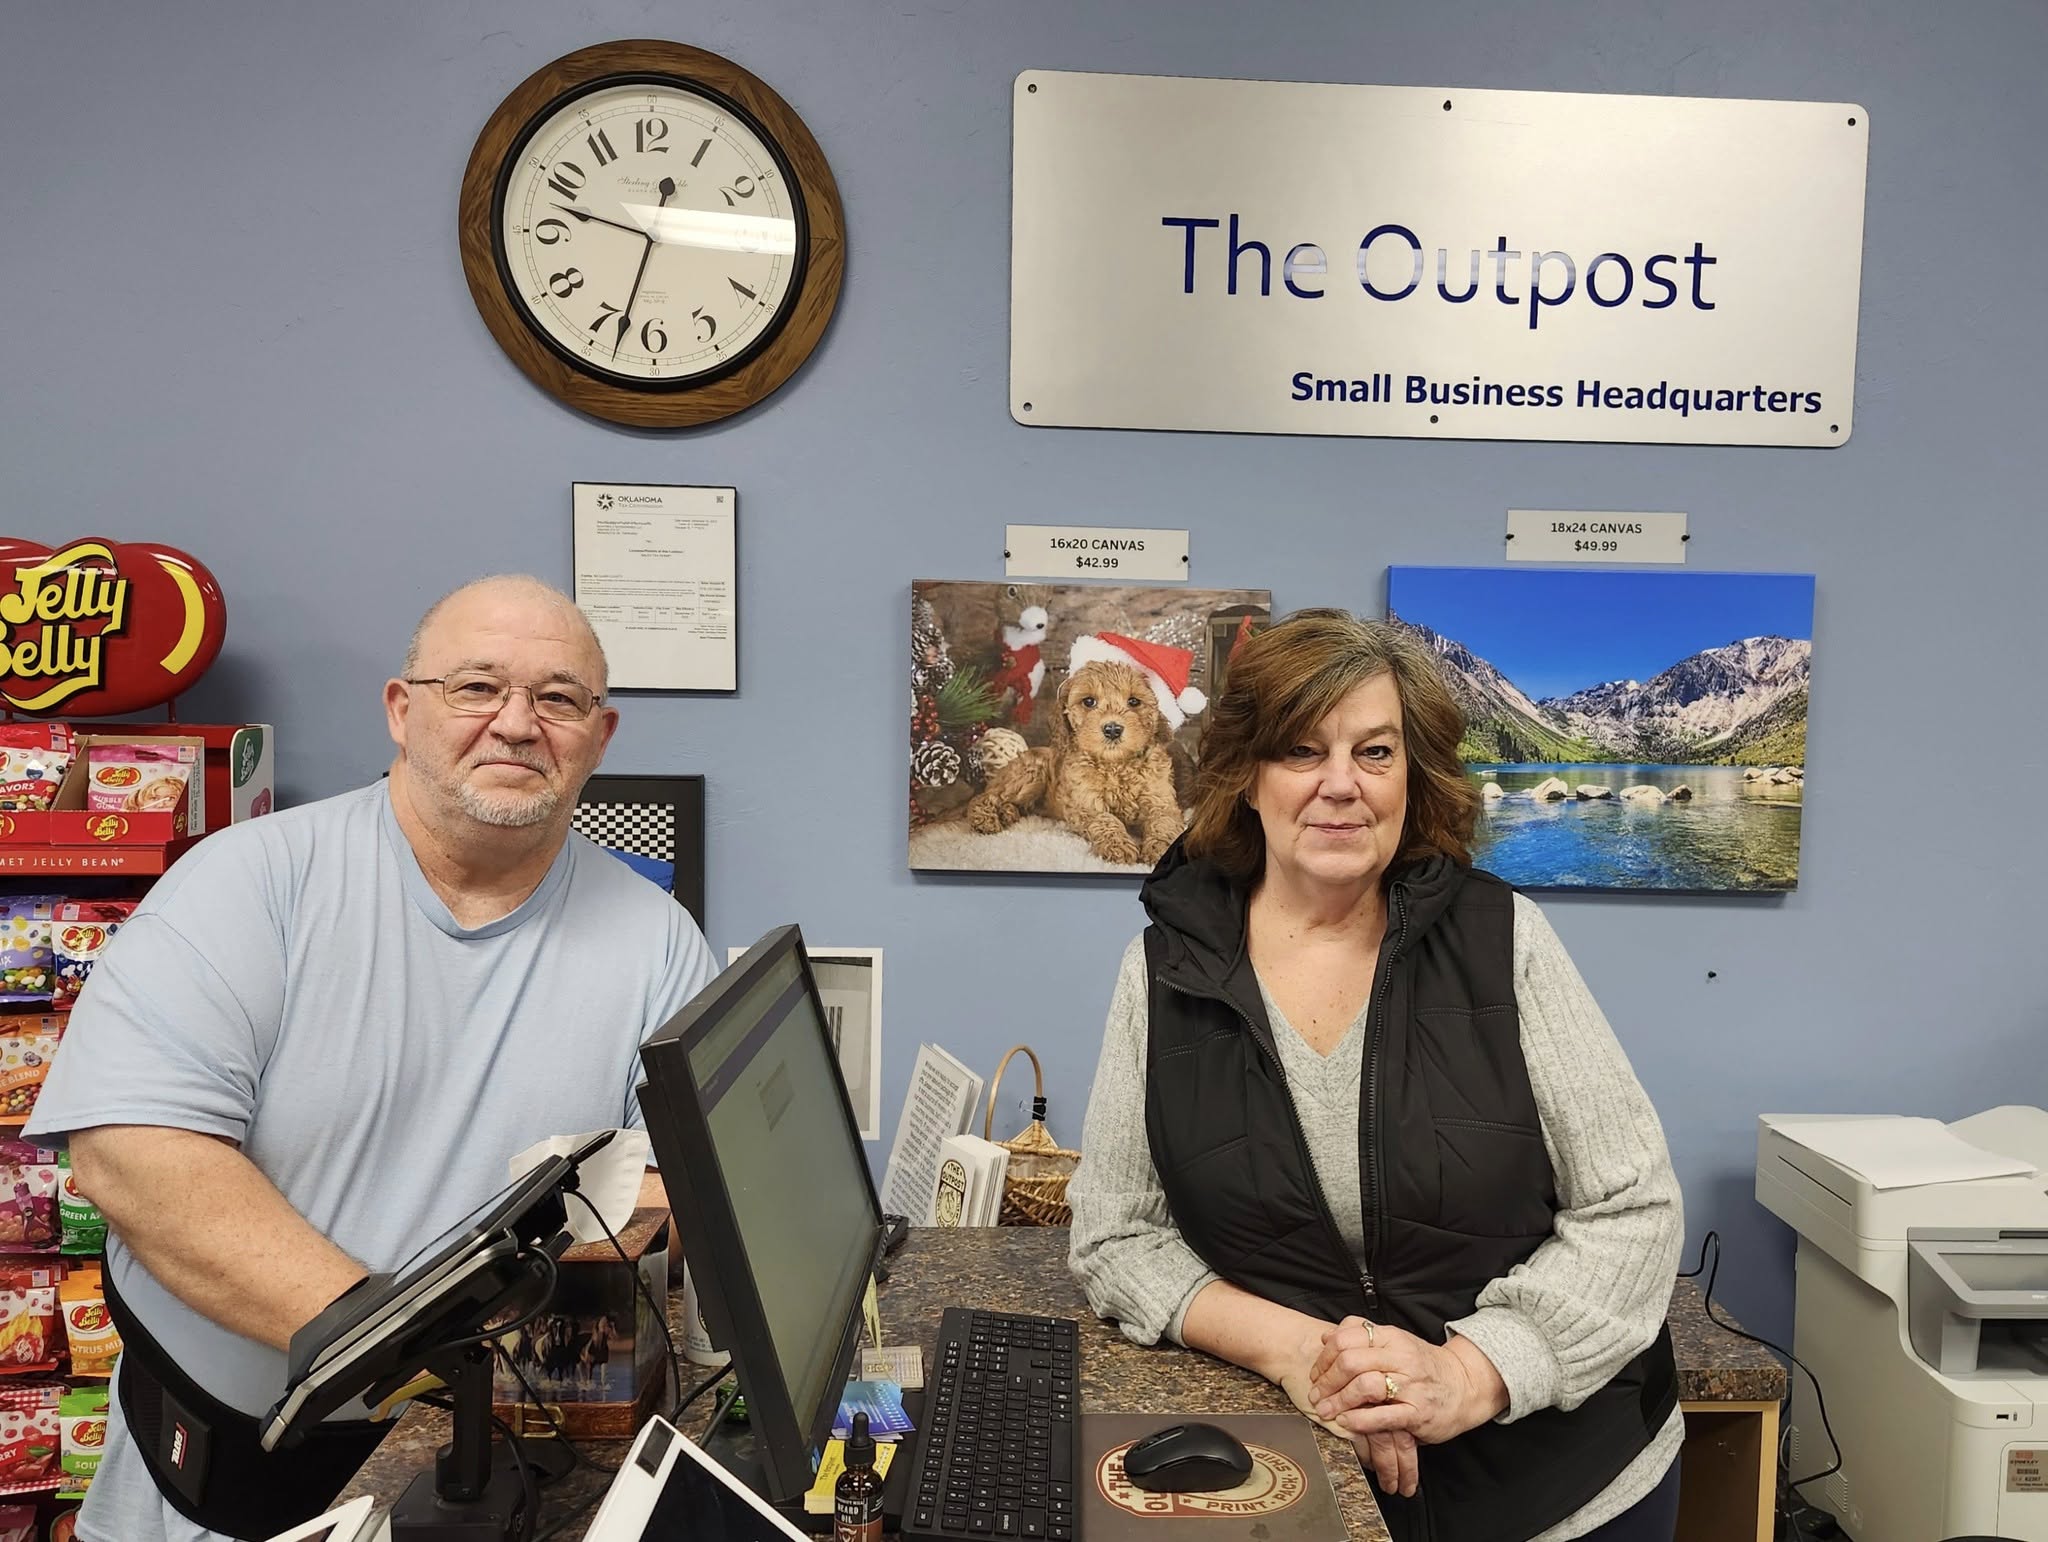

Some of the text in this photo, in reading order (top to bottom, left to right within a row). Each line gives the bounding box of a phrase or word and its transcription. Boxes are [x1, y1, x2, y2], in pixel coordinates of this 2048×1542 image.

[586, 128, 619, 167] 11
[635, 117, 669, 153] 12
[690, 138, 713, 168] 1
[548, 161, 587, 202] 10
[718, 175, 756, 207] 2
[535, 217, 572, 245] 9
[549, 267, 584, 299] 8
[1162, 213, 1718, 330] The Outpost
[726, 275, 757, 310] 4
[588, 301, 624, 333] 7
[690, 305, 717, 343] 5
[640, 317, 668, 354] 6
[649, 367, 661, 378] 30
[1290, 371, 1822, 418] Small Business Headquarters
[617, 495, 663, 504] OKLAHOMA
[1551, 522, 1643, 534] 18x24 CANVAS
[1050, 538, 1145, 551] 16x20 CANVAS
[1574, 540, 1618, 552] $49.99
[1075, 556, 1119, 569] $42.99
[0, 543, 127, 636] Jelly
[0, 782, 36, 794] AVORS
[0, 857, 24, 866] MET
[33, 857, 73, 867] JELLY
[8, 1069, 40, 1084] BLEND
[60, 1208, 87, 1221] GREEN
[0, 1448, 17, 1462] RRY
[75, 1460, 97, 1470] SOU
[1205, 1451, 1299, 1512] PRINT PACK SHIP
